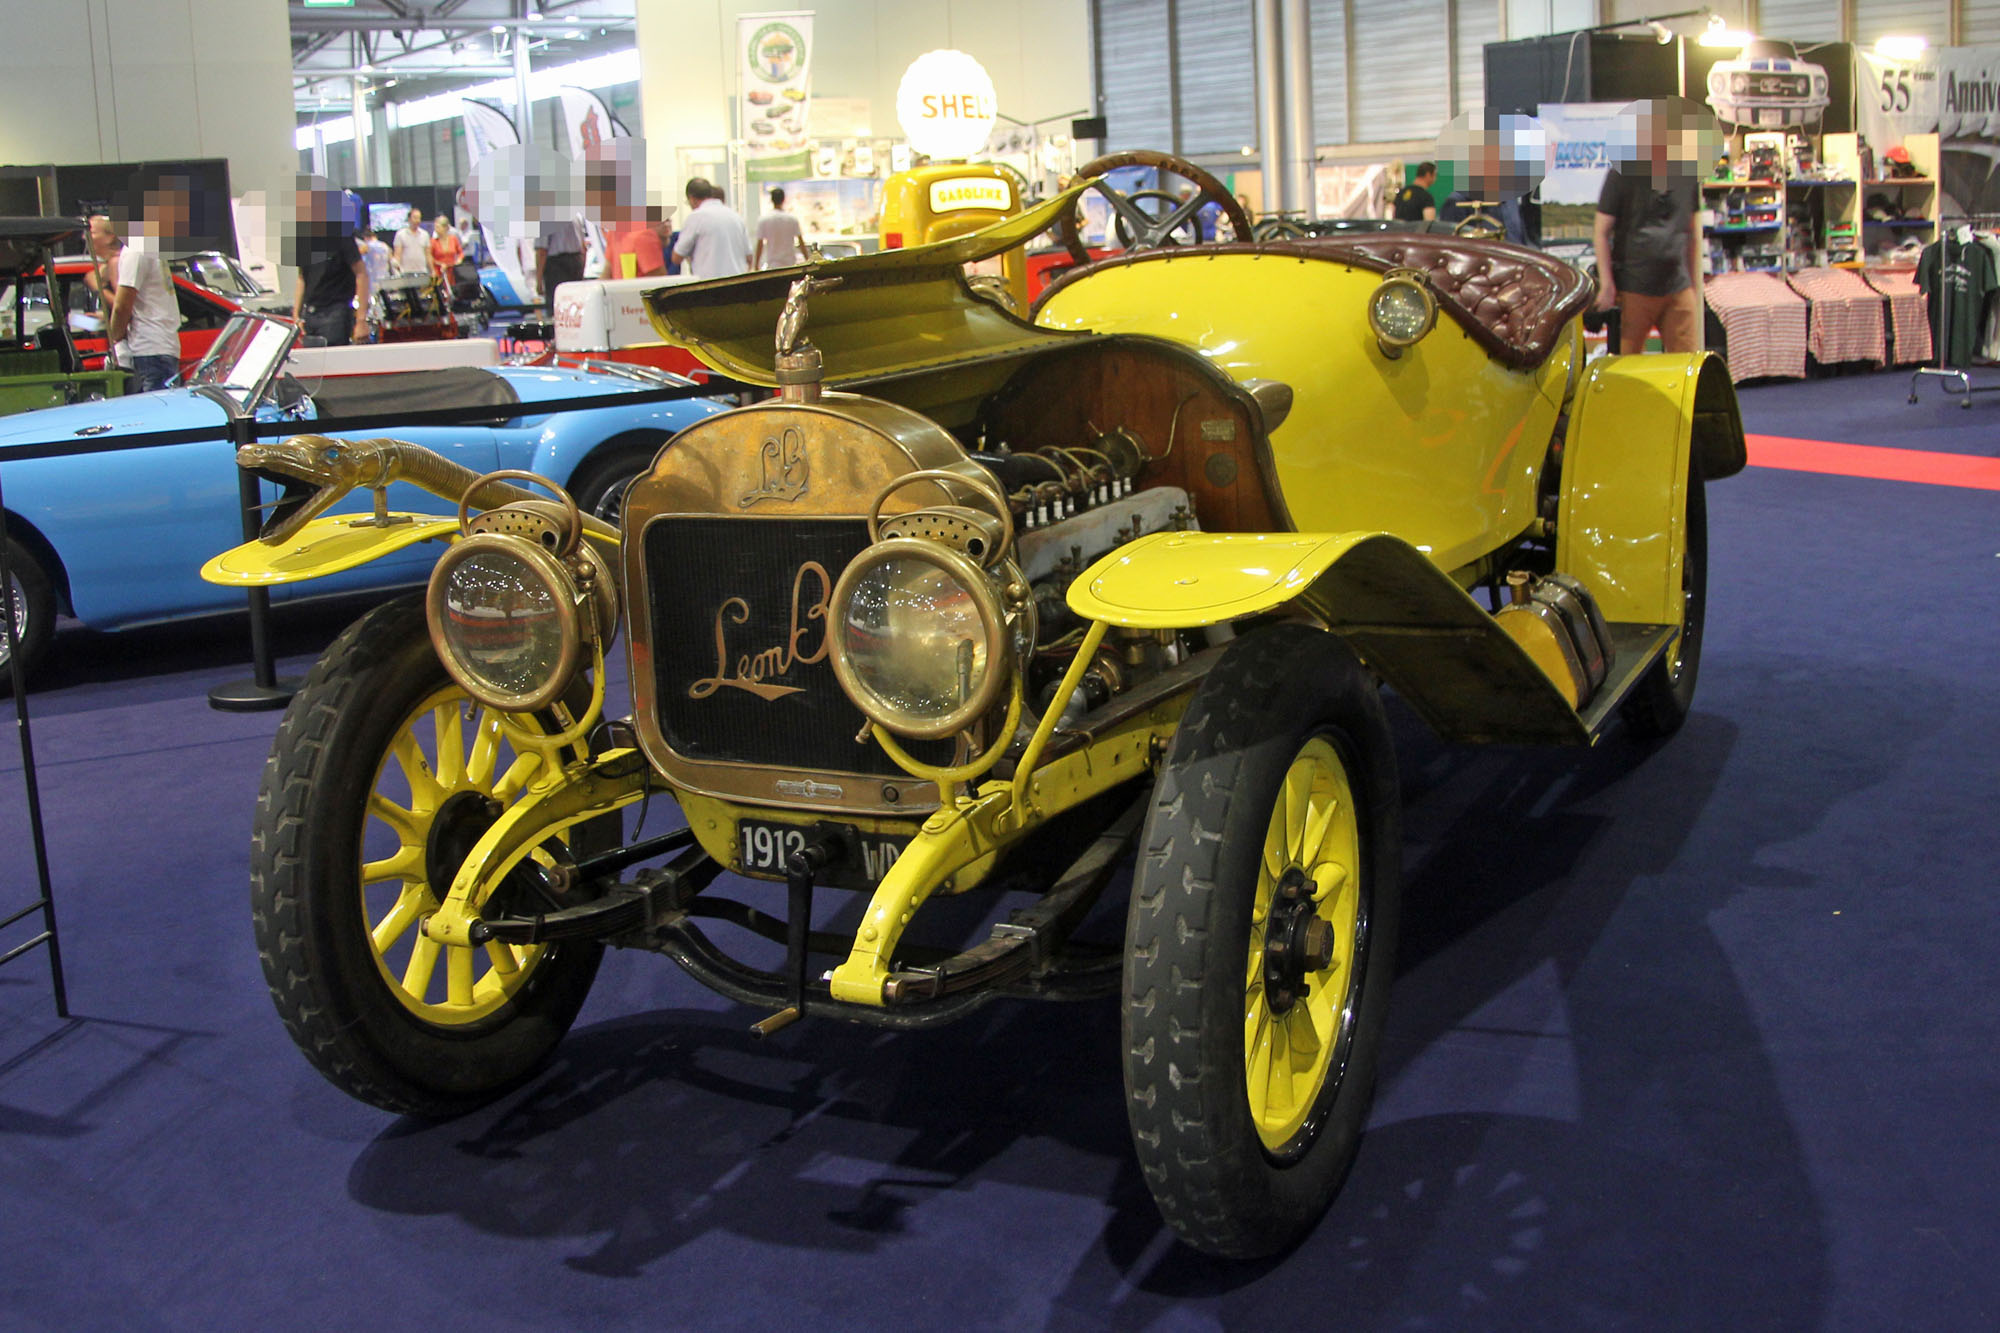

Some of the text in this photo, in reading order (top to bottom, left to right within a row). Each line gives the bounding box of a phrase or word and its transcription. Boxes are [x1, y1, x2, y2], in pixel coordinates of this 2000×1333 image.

[1881, 70, 1910, 112] 55
[1946, 68, 2000, 113] Anniv
[937, 187, 1003, 204] GASOLINE
